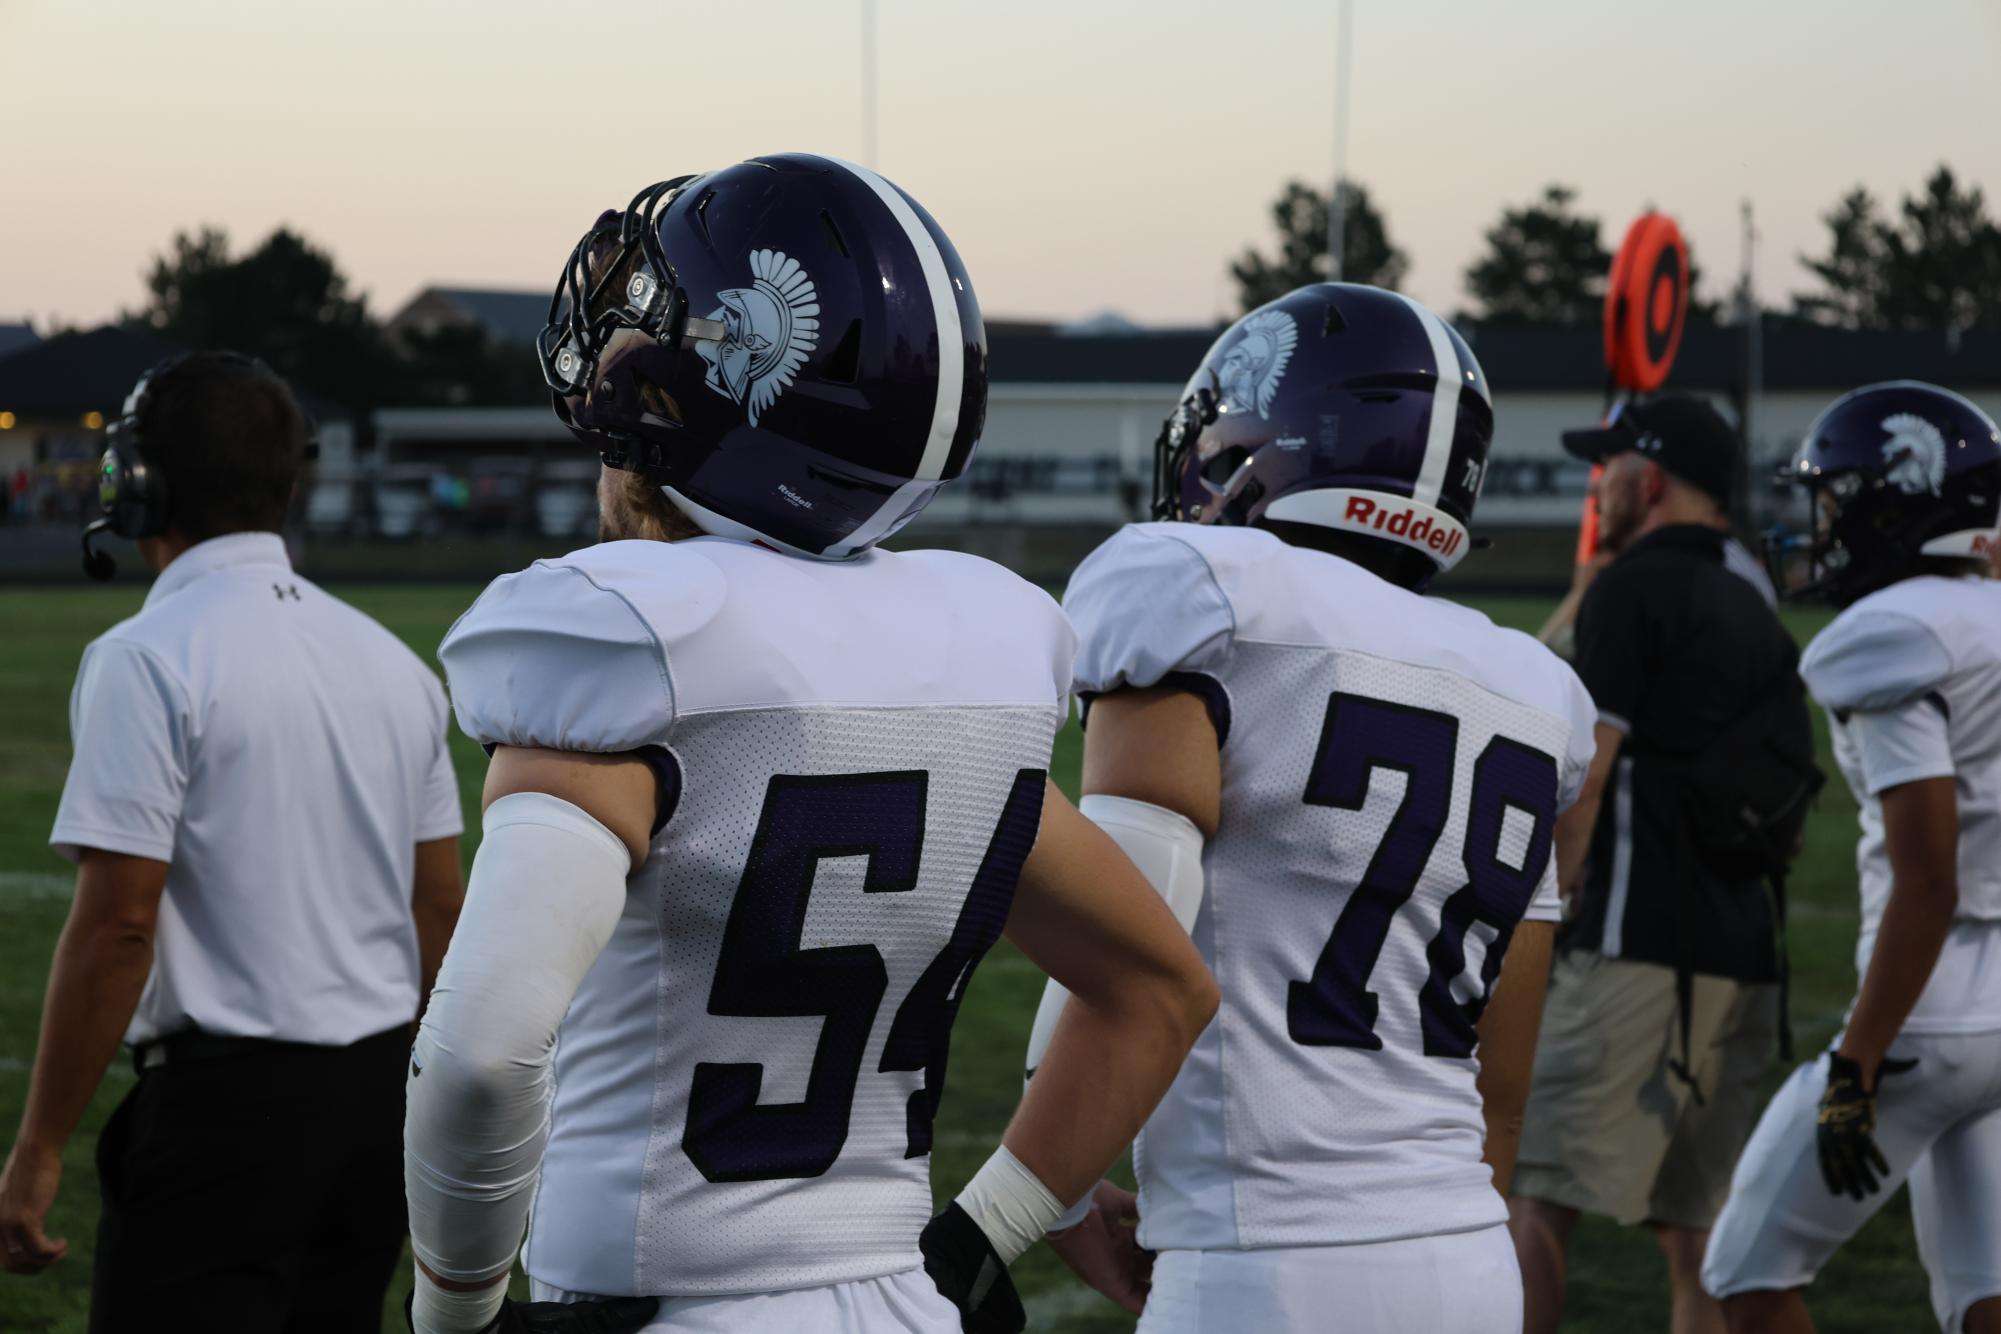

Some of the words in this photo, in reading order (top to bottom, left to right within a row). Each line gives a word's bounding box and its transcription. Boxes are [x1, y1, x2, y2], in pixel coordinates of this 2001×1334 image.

[778, 484, 813, 509] Riddell
[1344, 496, 1463, 557] Riddell
[1287, 691, 1558, 1058] 78
